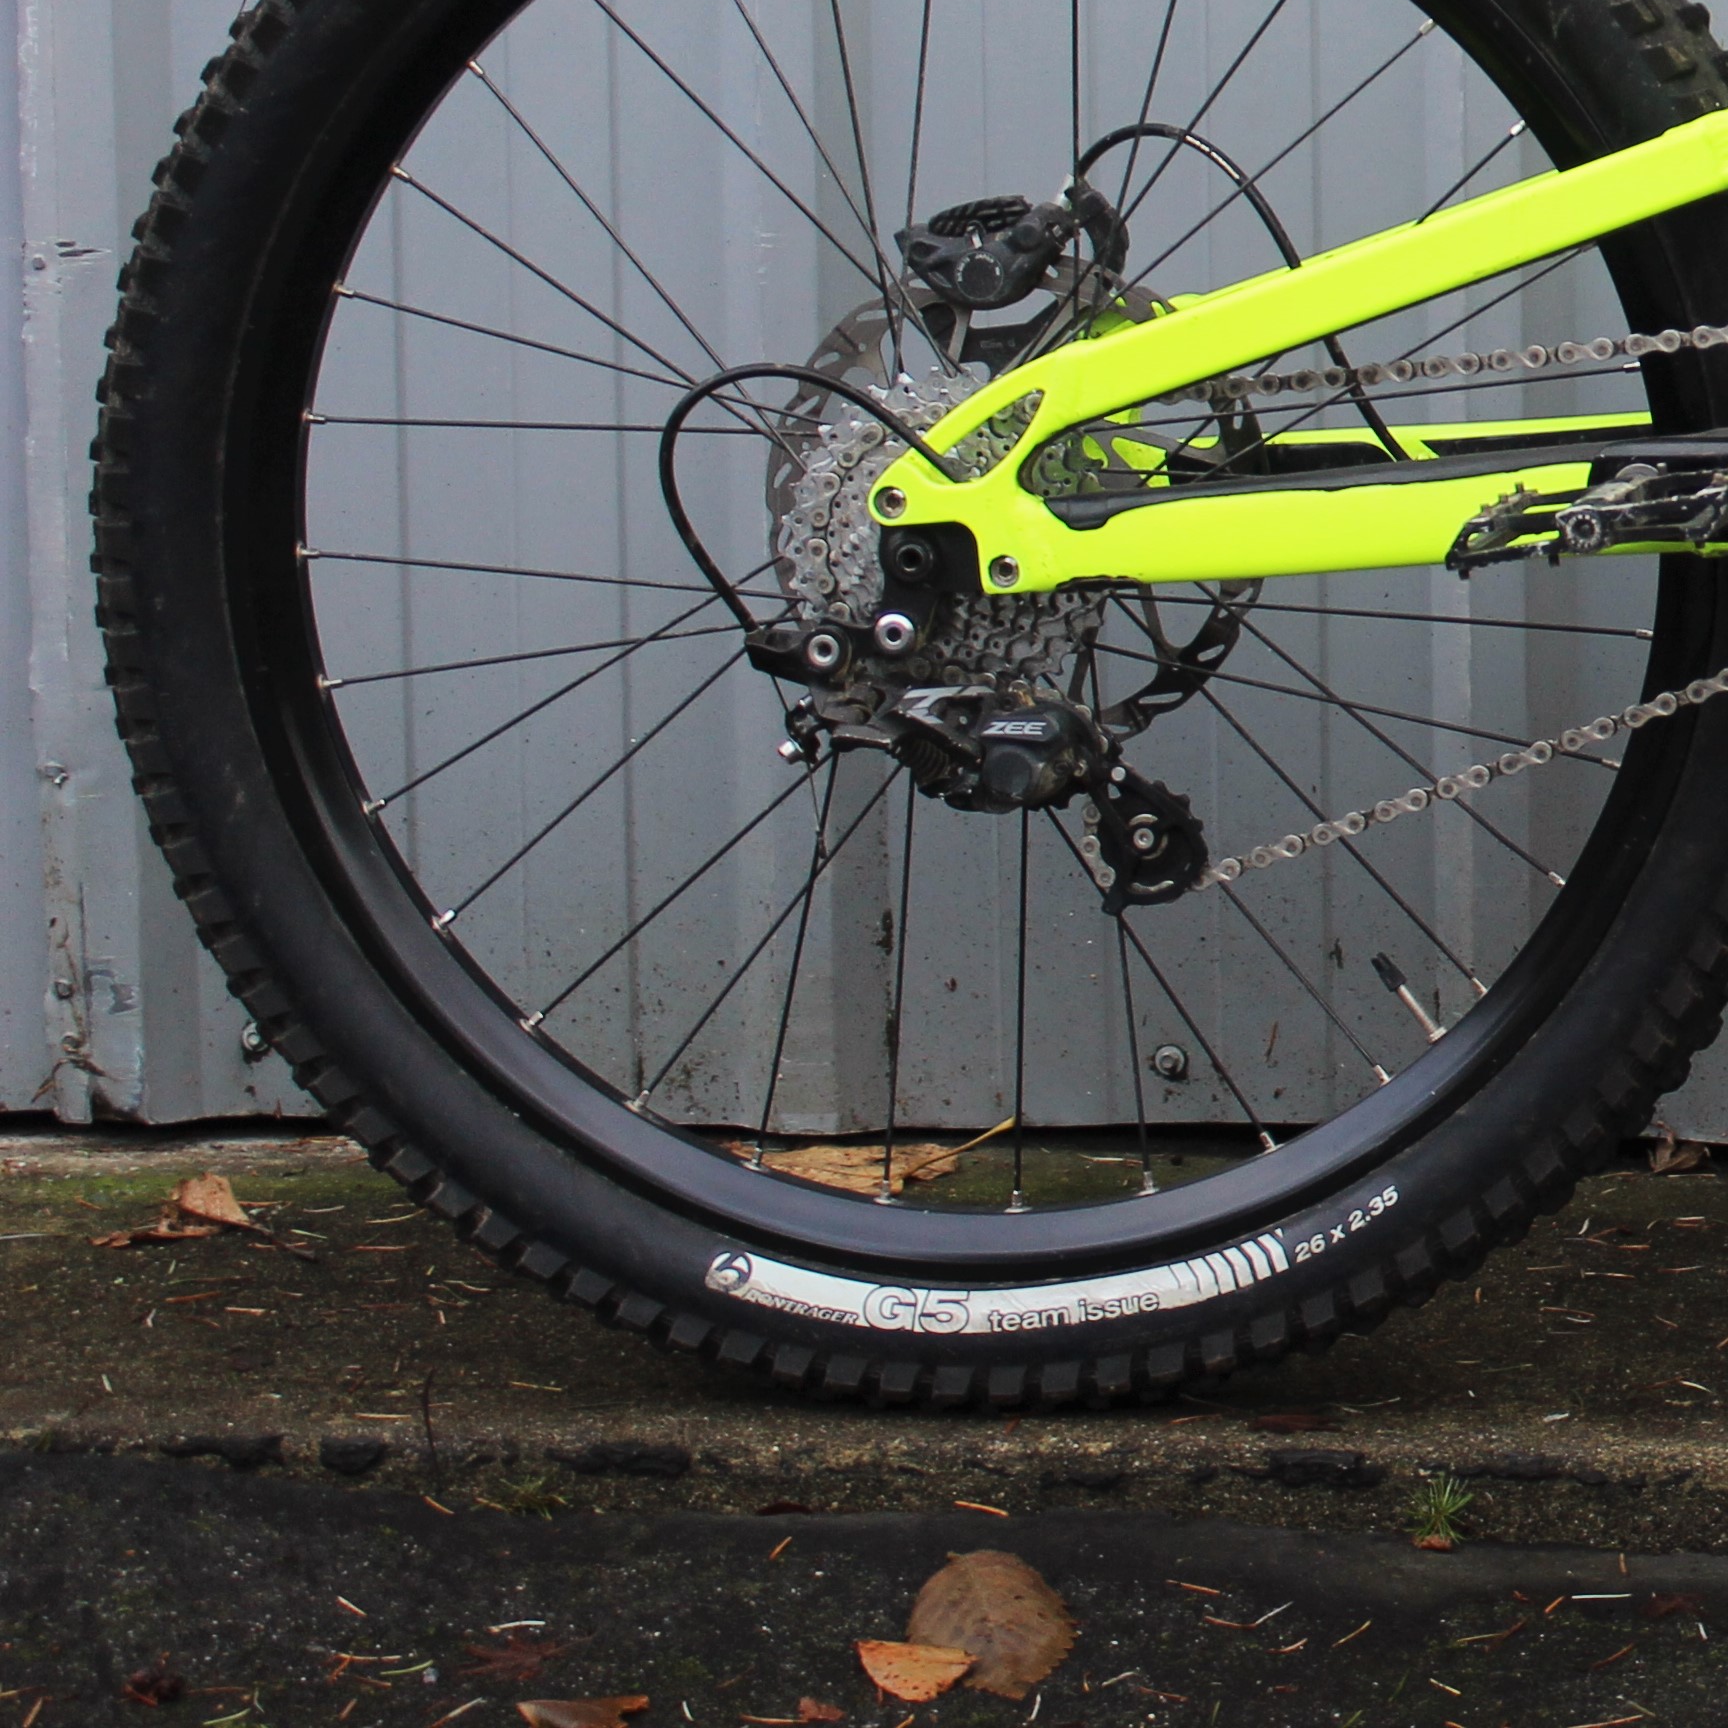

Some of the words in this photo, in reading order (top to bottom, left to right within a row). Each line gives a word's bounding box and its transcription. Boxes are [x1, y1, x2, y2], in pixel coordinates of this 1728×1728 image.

[981, 721, 1047, 735] ZEE
[863, 1285, 970, 1334] G5
[988, 1302, 1073, 1333] team
[1077, 1291, 1161, 1324] issue
[1294, 1233, 1326, 1264] 26
[1330, 1223, 1346, 1243] x
[1347, 1184, 1400, 1232] 2.35
